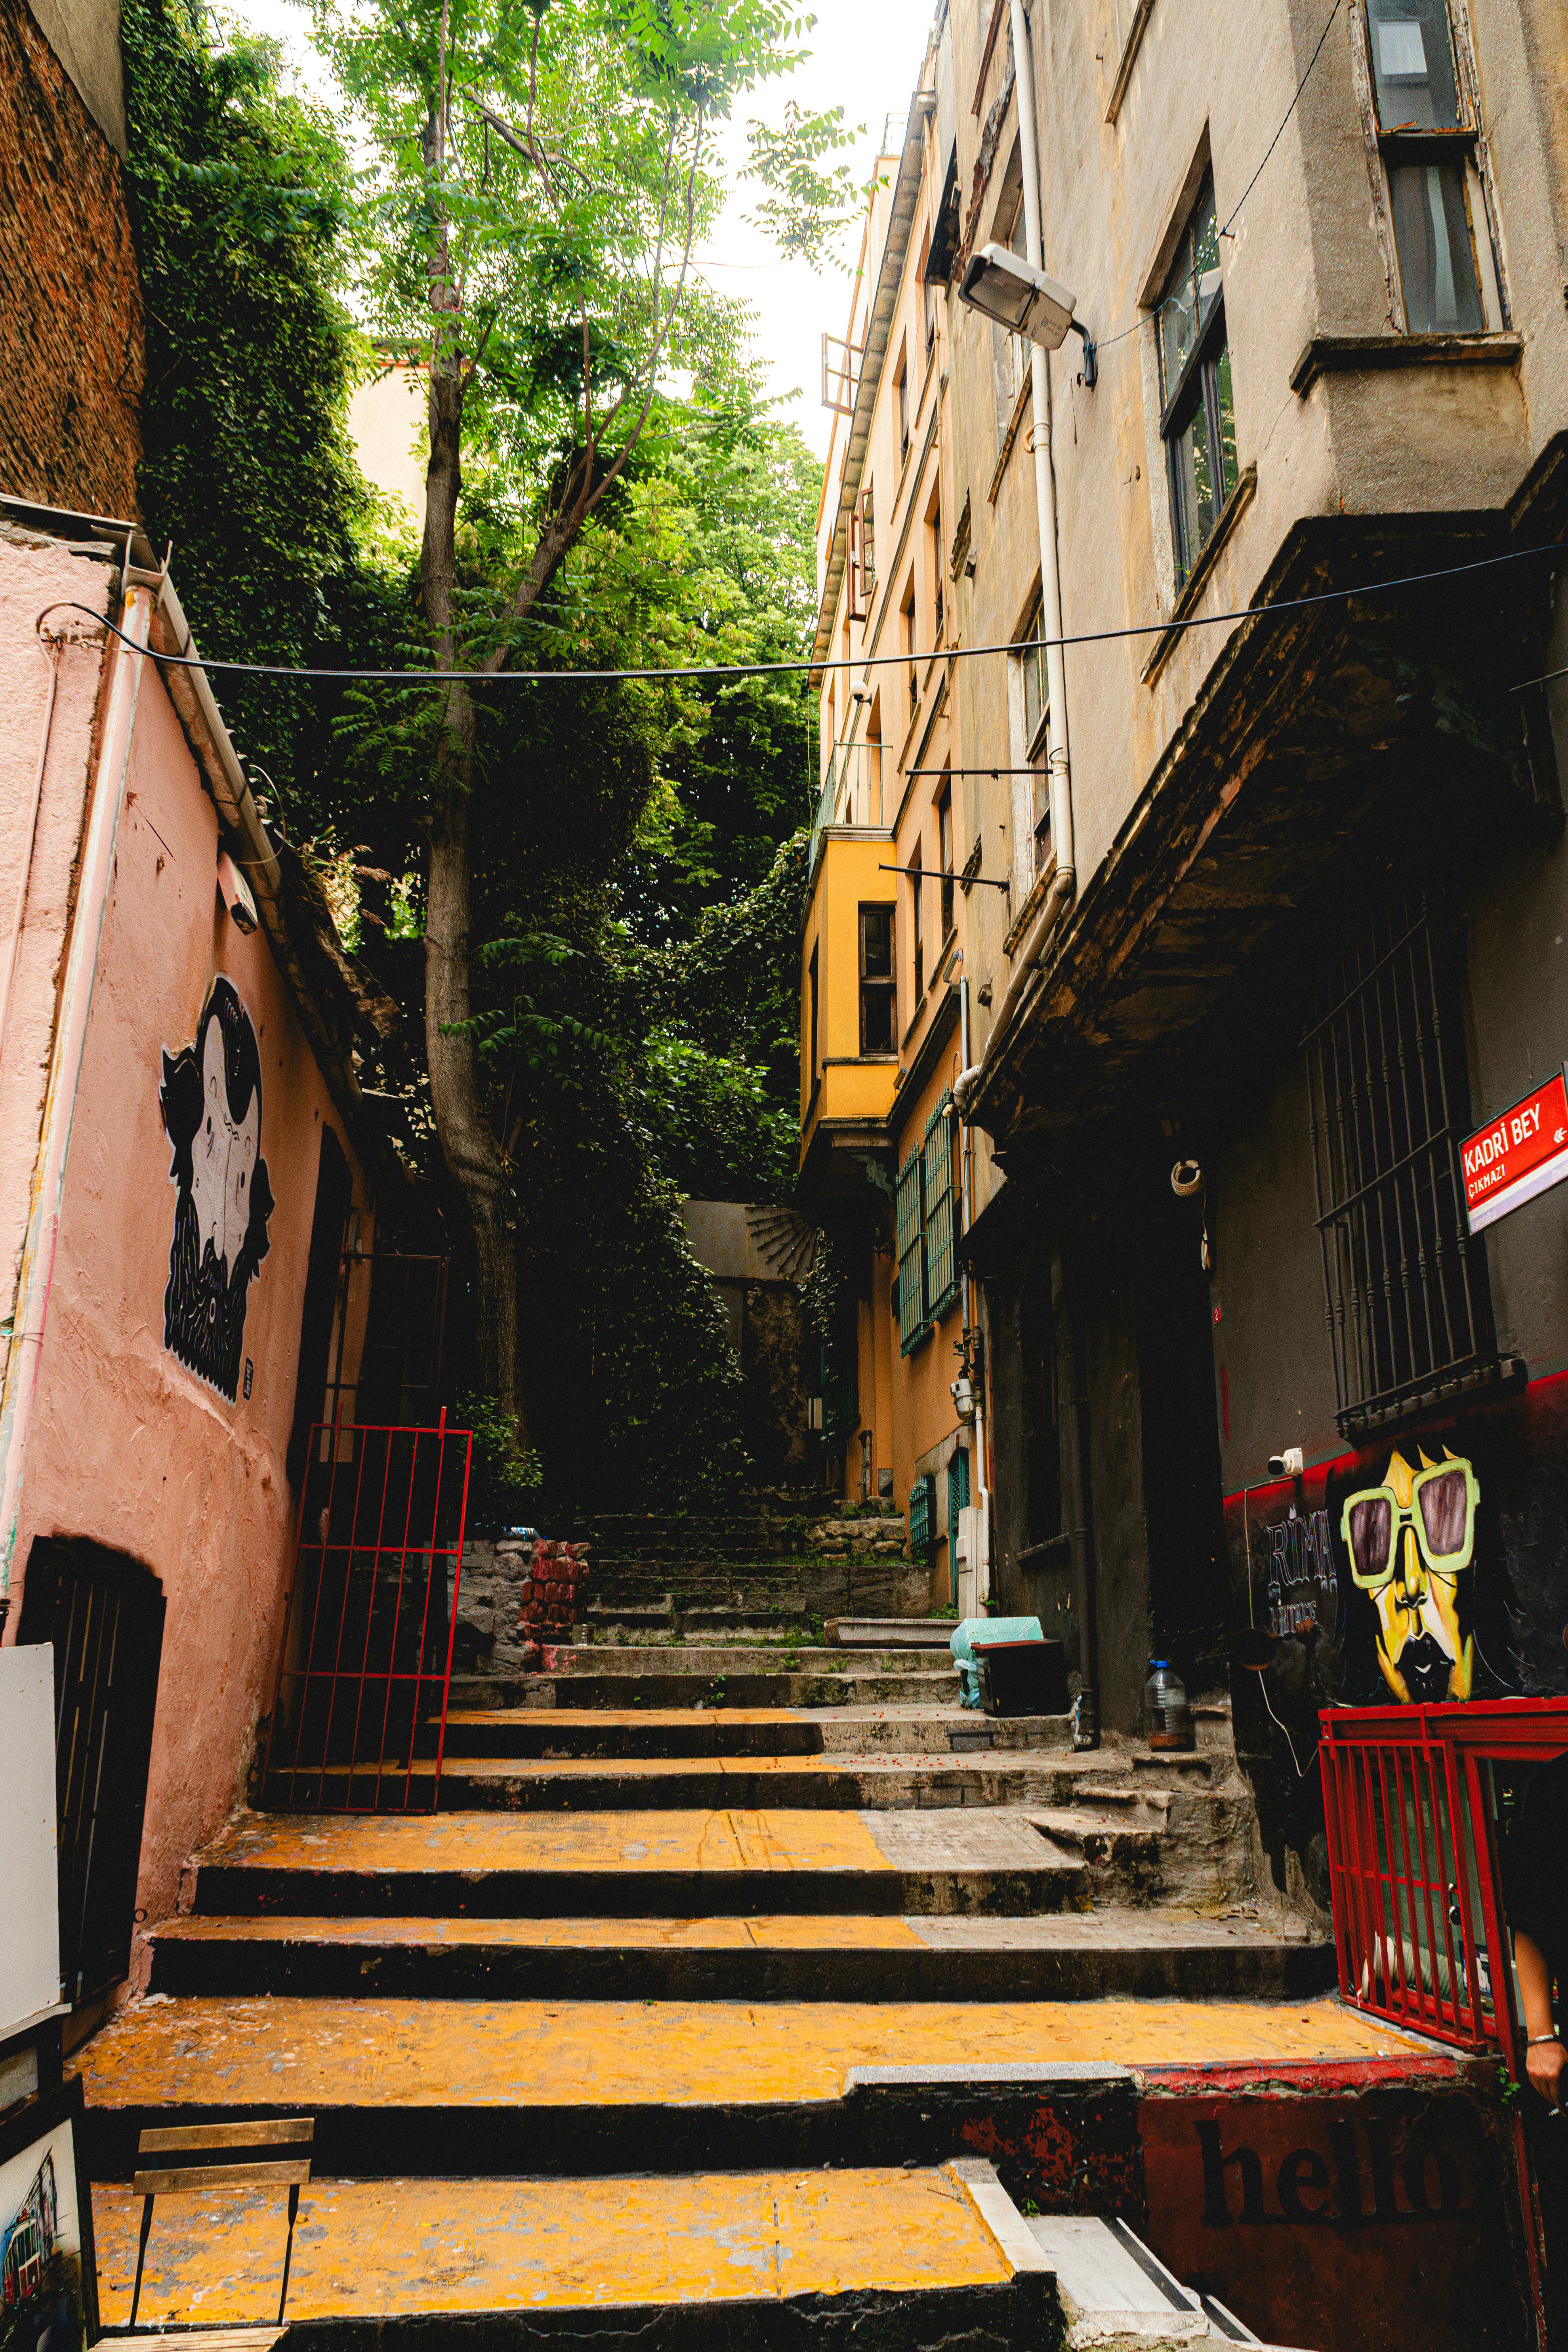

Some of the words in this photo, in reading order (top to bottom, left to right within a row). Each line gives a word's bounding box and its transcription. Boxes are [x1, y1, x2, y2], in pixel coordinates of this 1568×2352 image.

[1464, 1123, 1509, 1176] KADRİ
[1511, 1103, 1539, 1146] BEY
[1469, 1164, 1505, 1199] ÇIKMAZI
[1194, 2117, 1466, 2227] hello
